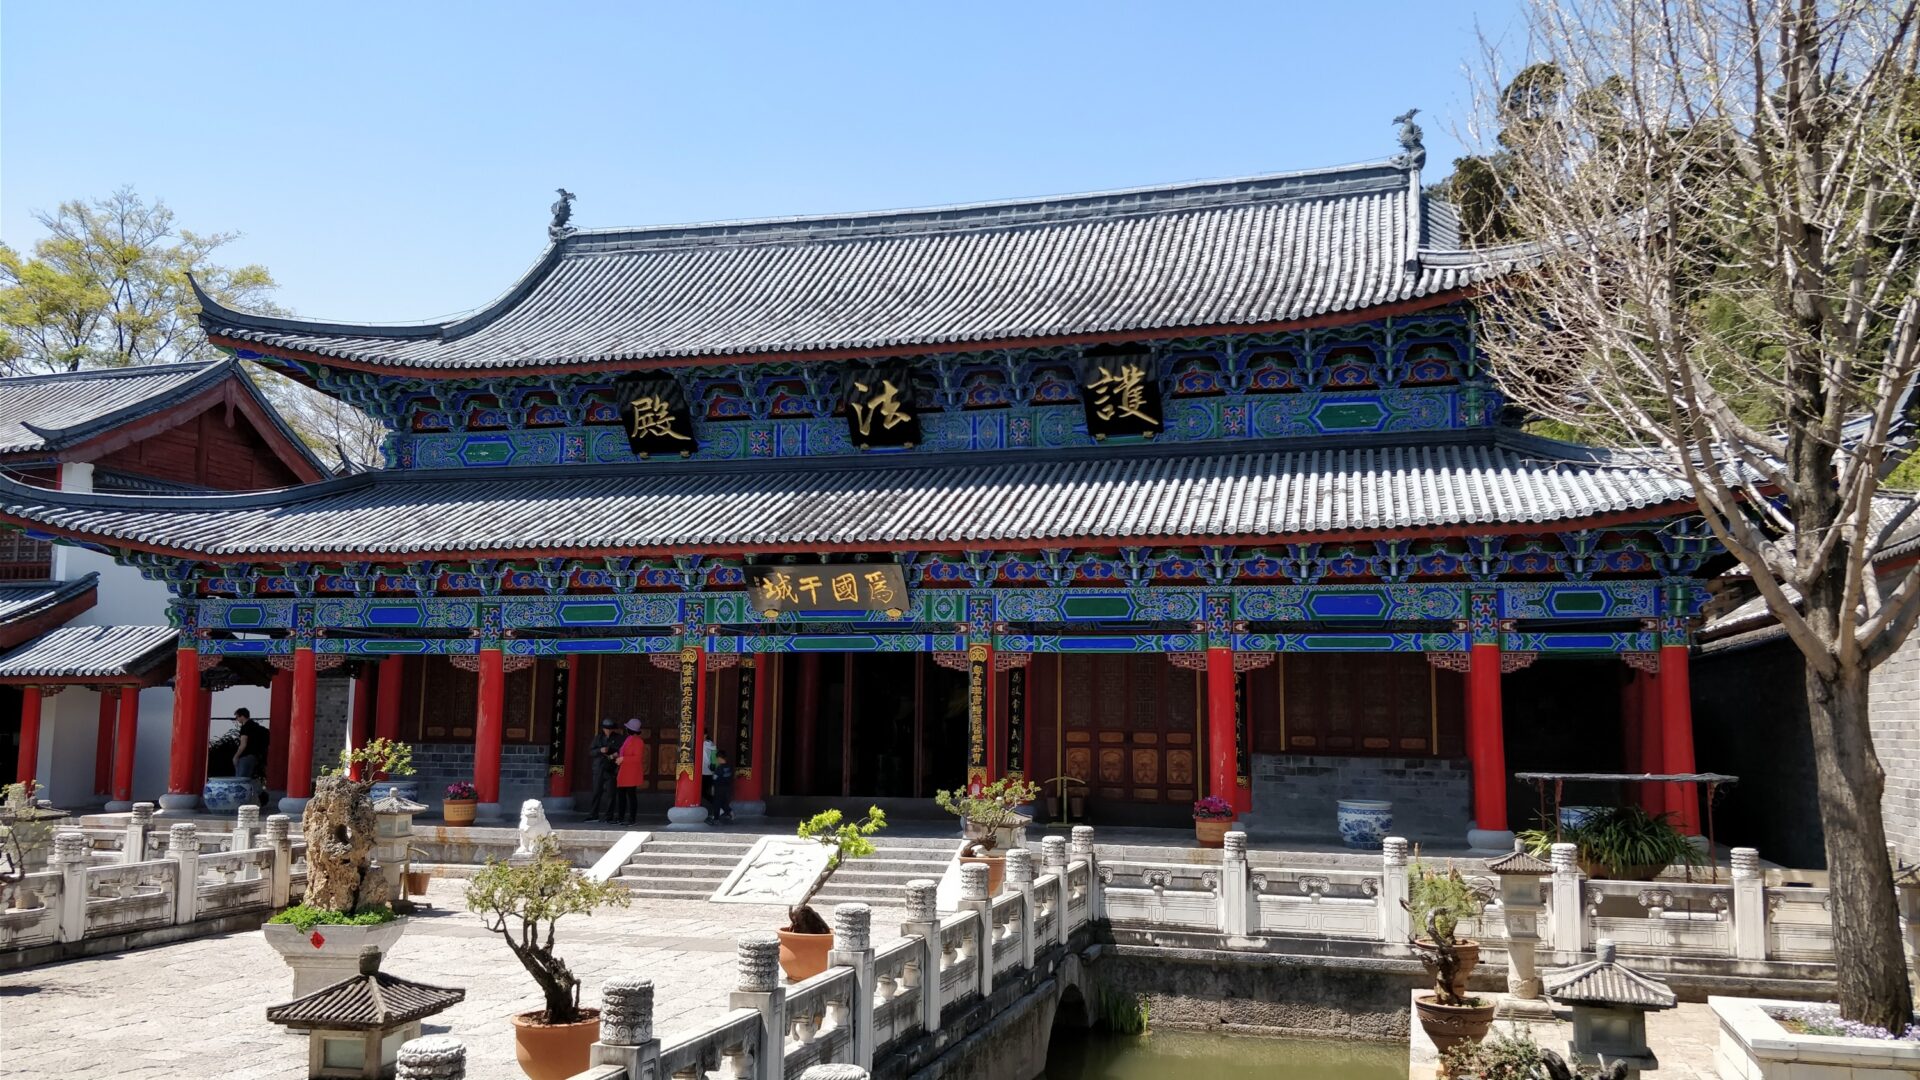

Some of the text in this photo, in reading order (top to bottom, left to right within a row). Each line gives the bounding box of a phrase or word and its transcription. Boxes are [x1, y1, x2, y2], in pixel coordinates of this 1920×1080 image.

[631, 367, 1158, 441] 護 法 殿
